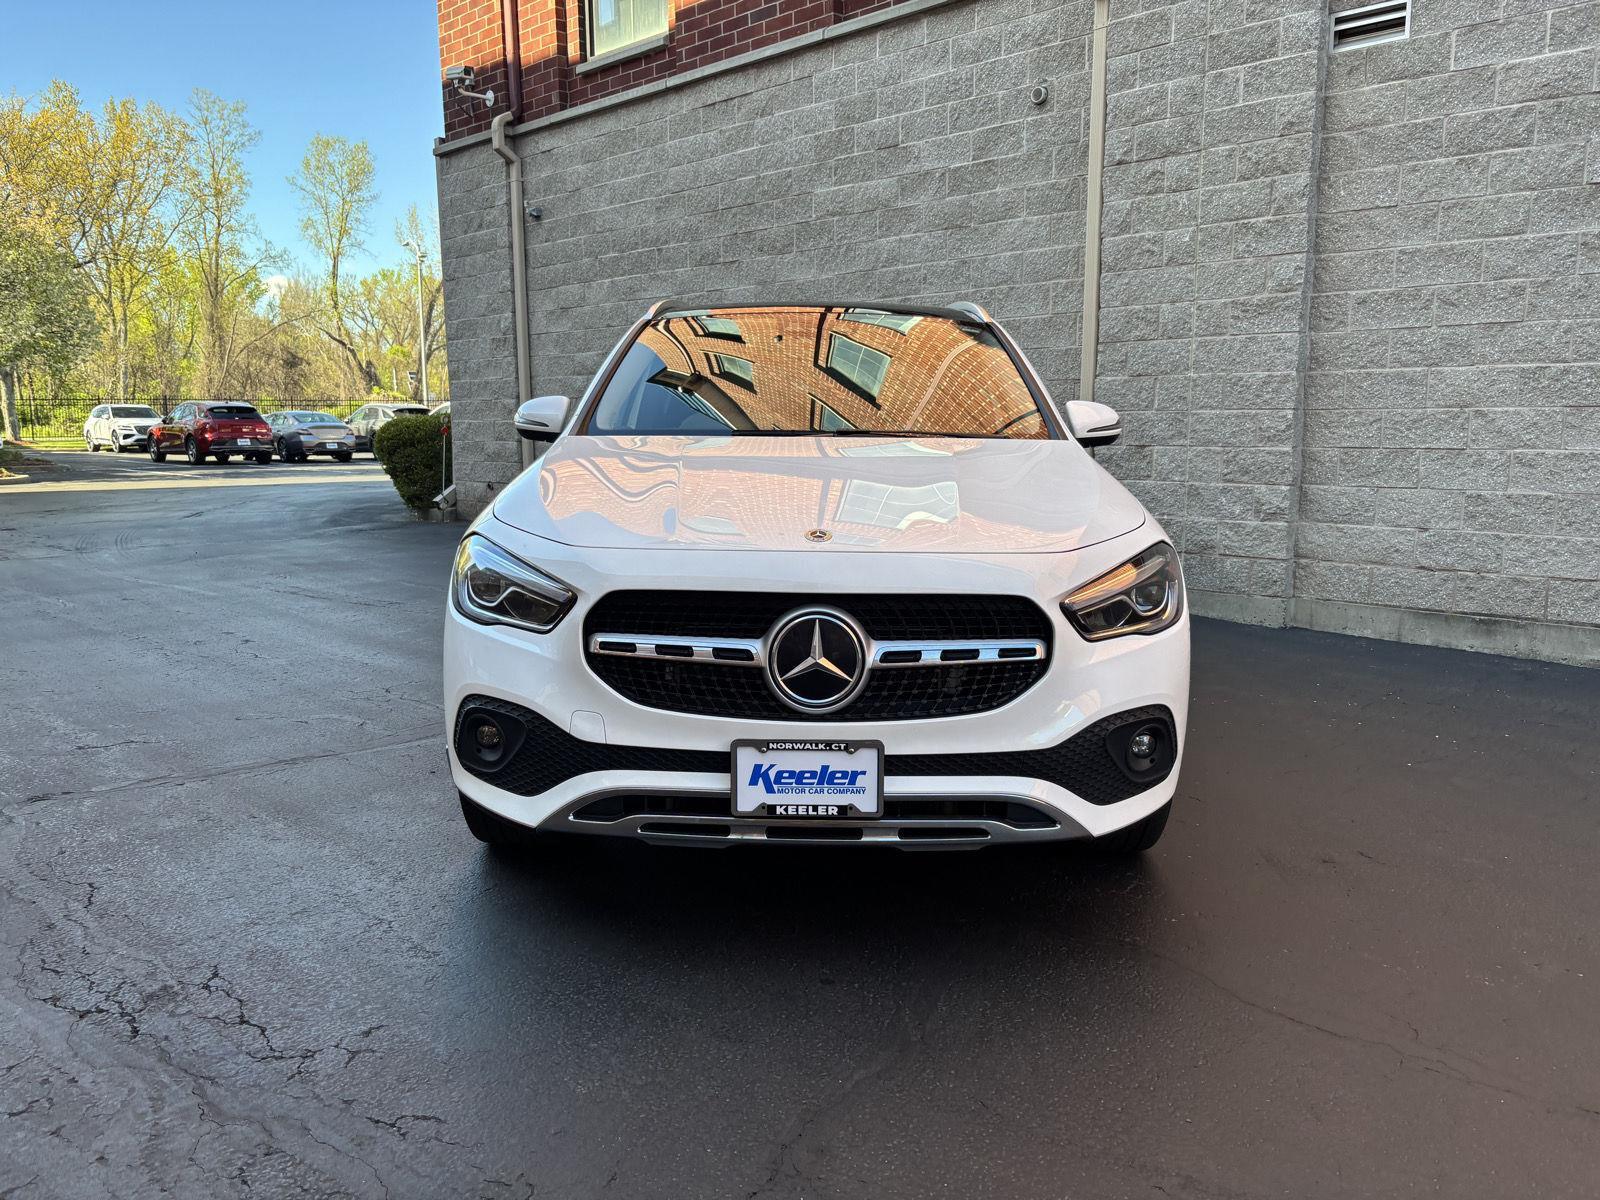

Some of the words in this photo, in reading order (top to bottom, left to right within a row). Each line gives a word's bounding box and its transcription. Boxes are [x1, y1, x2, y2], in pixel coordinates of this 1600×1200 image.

[748, 763, 867, 794] Keeler
[777, 787, 806, 795] MOTOR
[808, 787, 825, 795] CAR
[827, 787, 867, 795] COMPANY
[775, 805, 838, 815] KEELER
